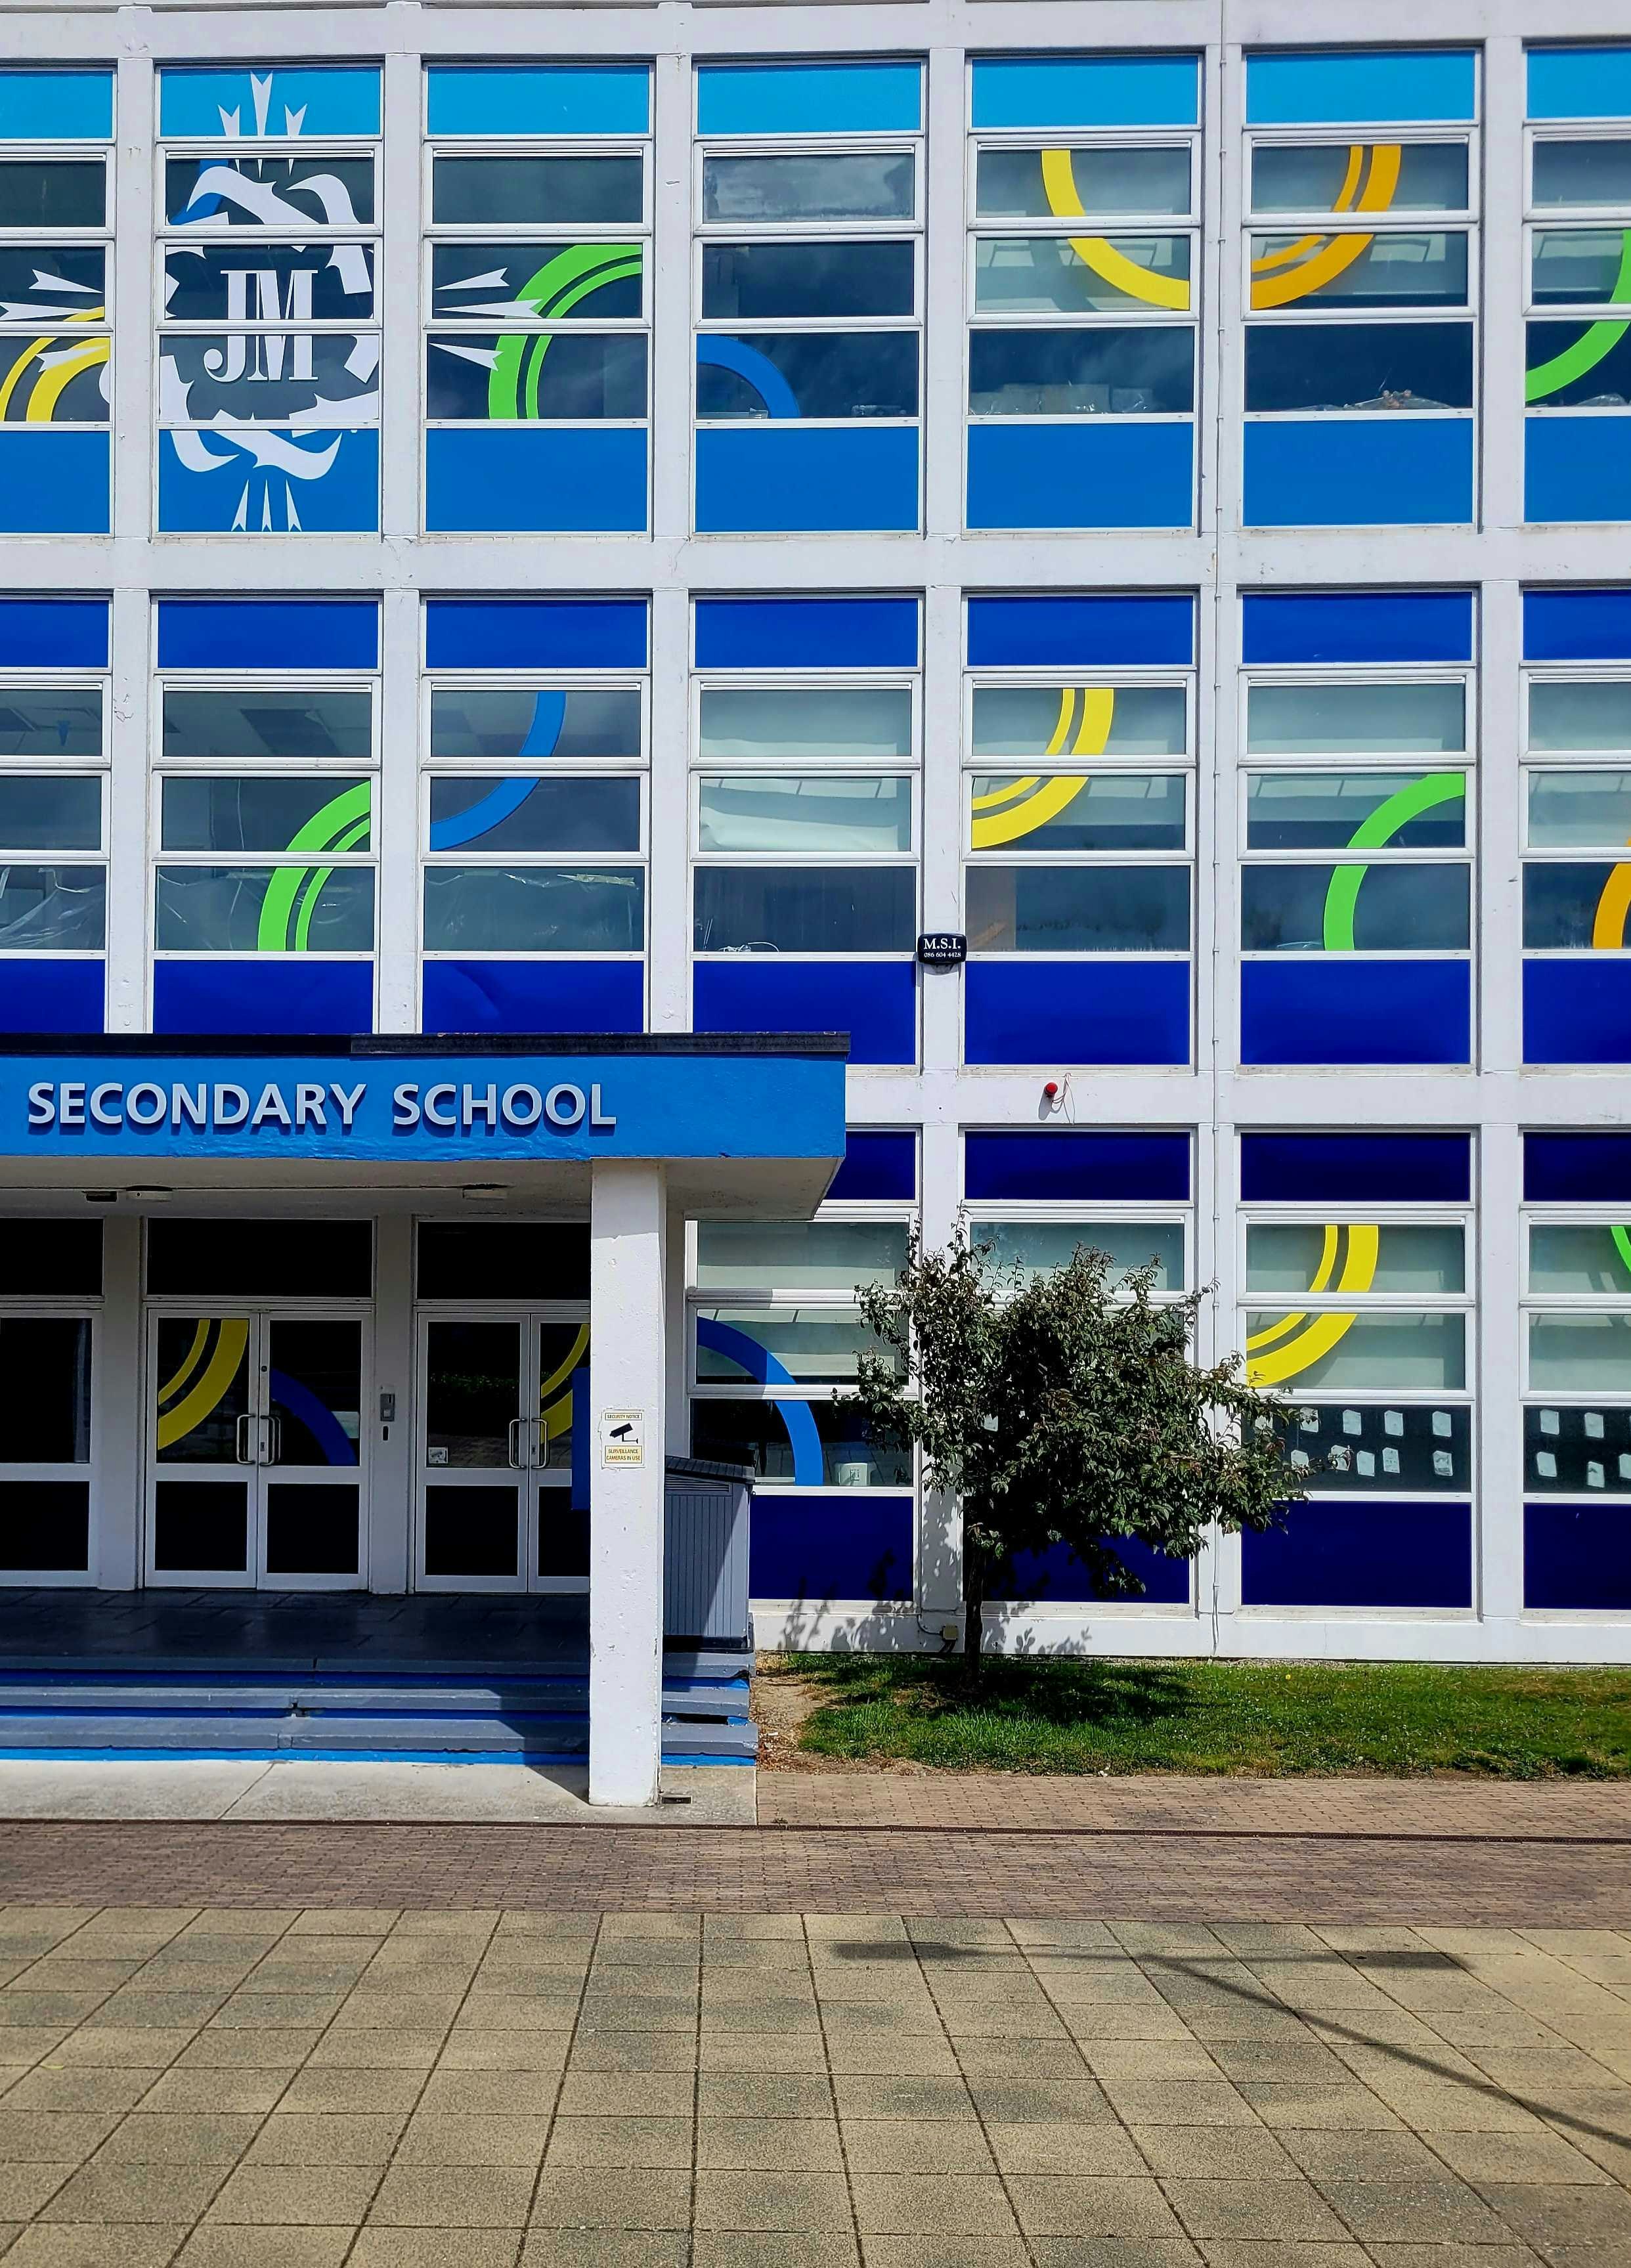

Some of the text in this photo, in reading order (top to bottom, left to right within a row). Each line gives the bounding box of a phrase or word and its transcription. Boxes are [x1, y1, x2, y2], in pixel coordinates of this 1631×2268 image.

[204, 270, 318, 382] JM
[923, 938, 961, 949] M.S.I.
[28, 1082, 617, 1125] SECONDARY SCHOOL
